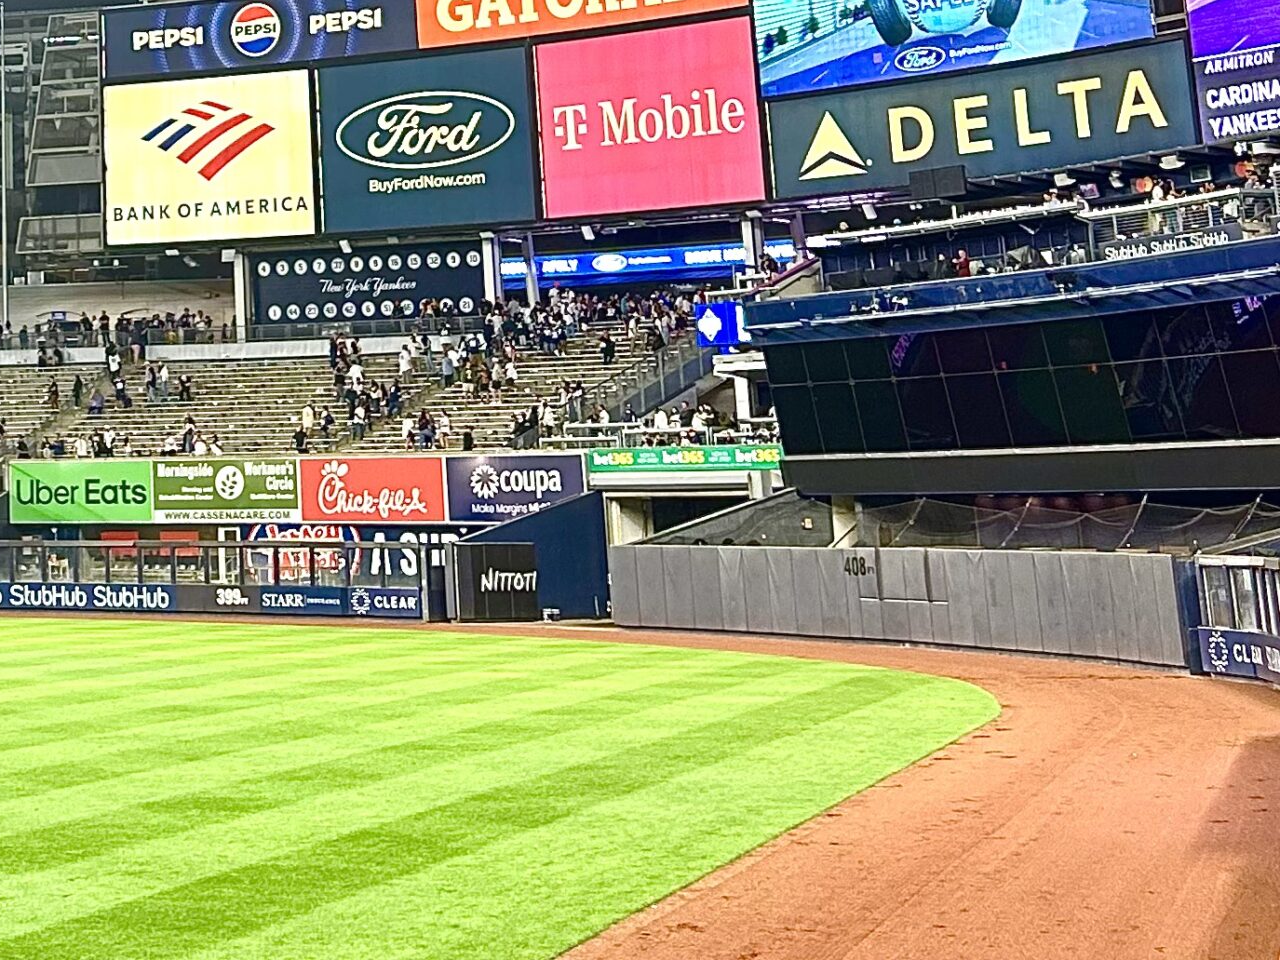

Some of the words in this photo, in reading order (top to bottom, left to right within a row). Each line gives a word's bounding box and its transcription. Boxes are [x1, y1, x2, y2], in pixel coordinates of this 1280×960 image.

[234, 22, 277, 37] PEPSI
[309, 8, 382, 35] PEPSI
[132, 26, 204, 51] PEPSI
[903, 50, 936, 68] Ford
[1205, 50, 1275, 75] ARMITRON
[598, 88, 745, 147] Mobile
[888, 70, 1168, 164] DELTA
[367, 102, 483, 158] Ford
[369, 172, 486, 194] BuyFordNow.com
[113, 204, 171, 222] BANK
[177, 202, 204, 218] OF
[210, 196, 309, 216] AMERICA
[319, 279, 344, 293] New
[344, 278, 372, 298] York
[372, 276, 417, 297] Yankees
[16, 479, 79, 505] Uber
[85, 478, 147, 505] Eats
[318, 473, 428, 519] Chick-fil-A
[499, 469, 562, 499] coupa
[844, 556, 866, 576] 408
[9, 584, 87, 607] StubHub
[93, 585, 169, 608] StubHub
[216, 589, 241, 605] 399
[261, 593, 304, 607] STARR
[373, 596, 418, 609] CLEAR
